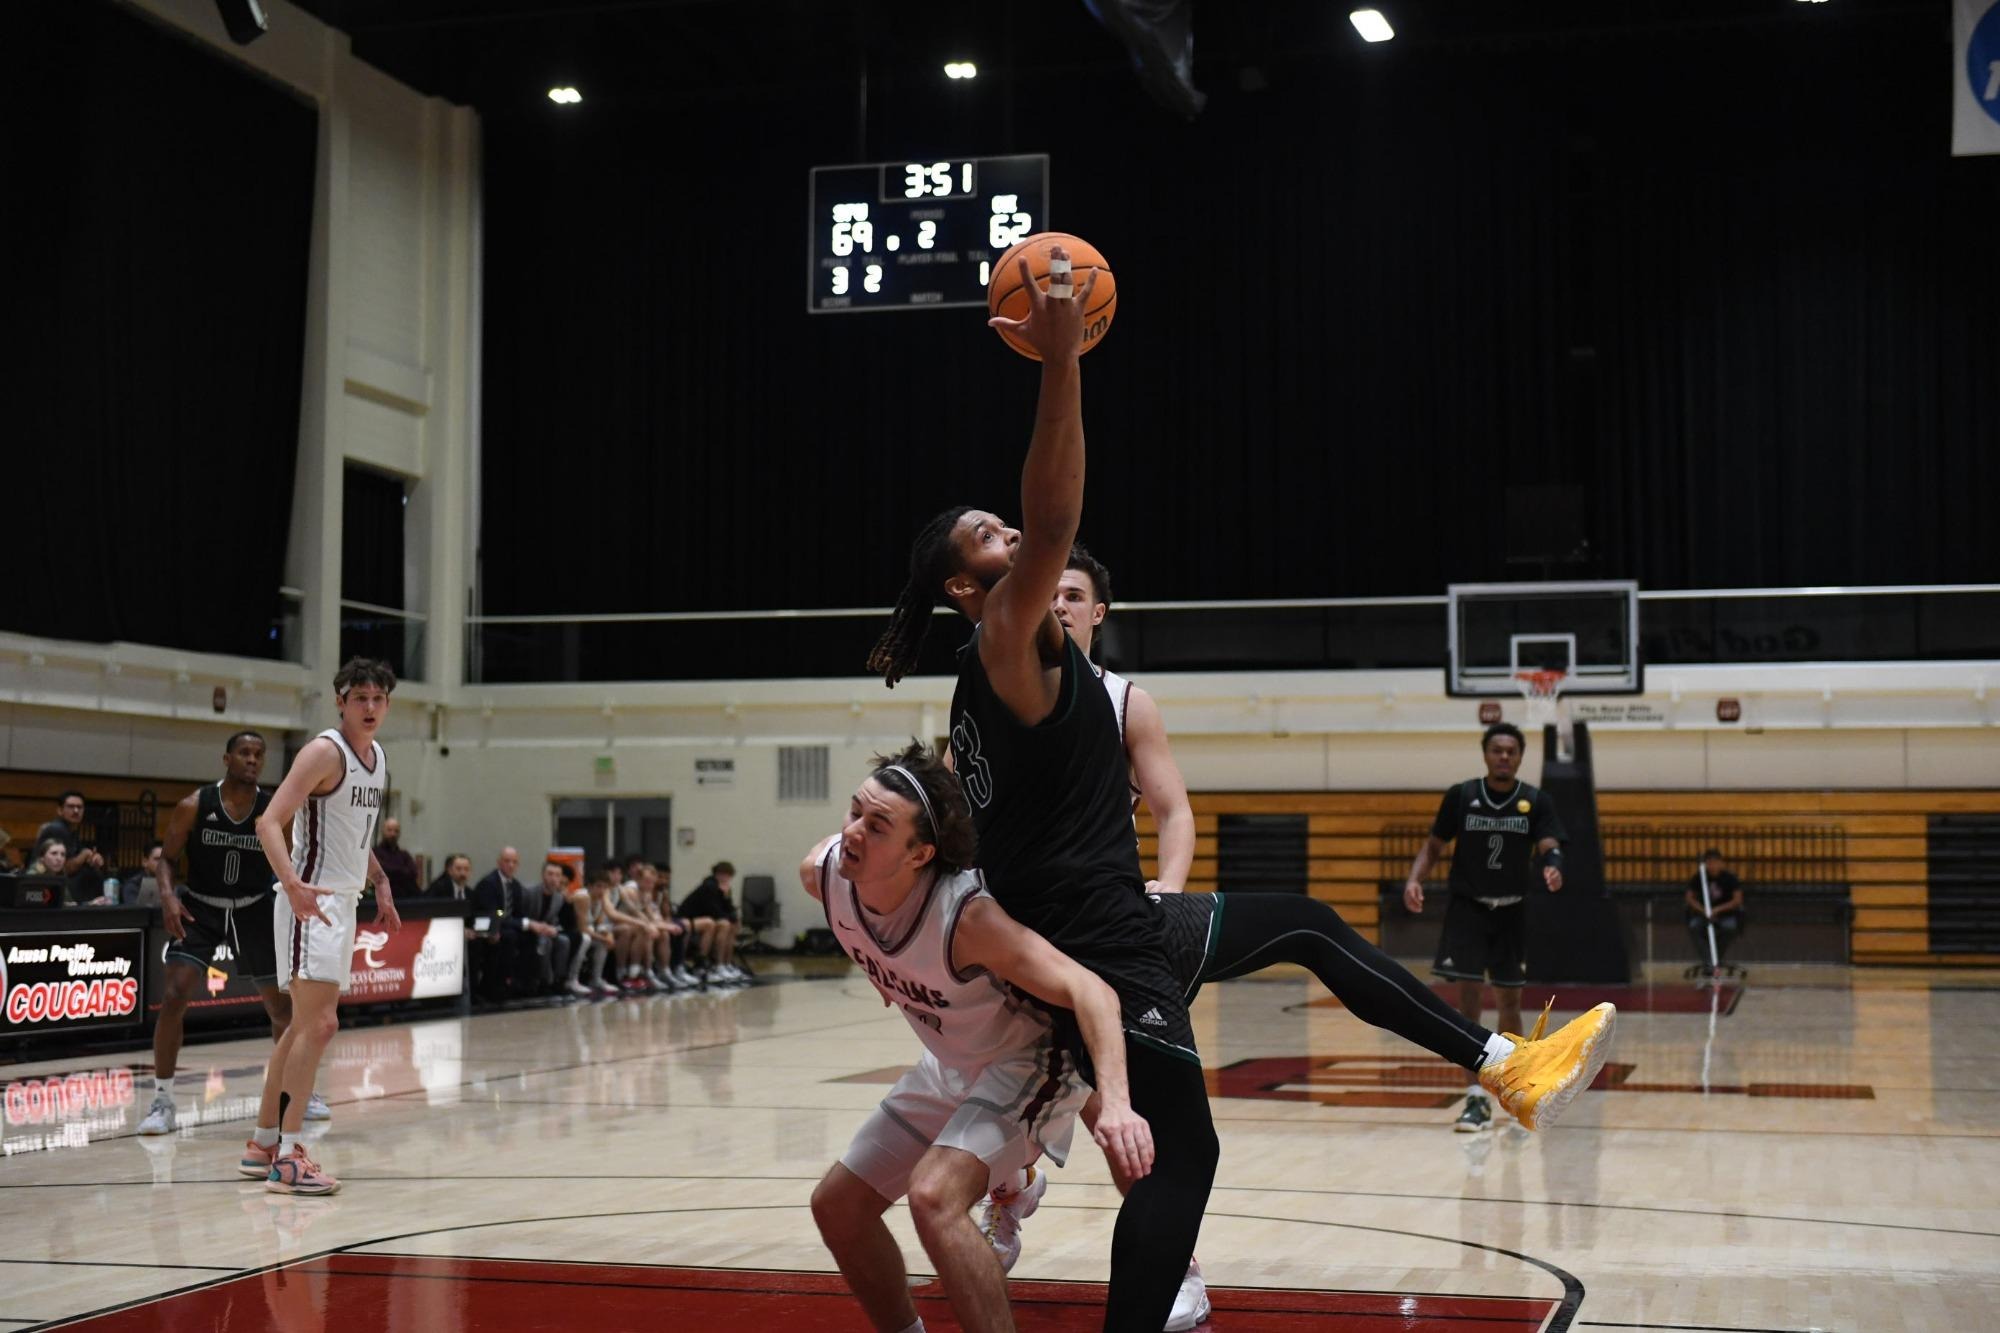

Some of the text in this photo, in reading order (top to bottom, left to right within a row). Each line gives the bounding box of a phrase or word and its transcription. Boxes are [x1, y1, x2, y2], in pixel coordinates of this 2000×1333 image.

[905, 162, 972, 198] 3:51
[832, 221, 873, 256] 69
[918, 221, 936, 248] 2
[990, 212, 1031, 248] 62
[832, 266, 848, 294] 3
[864, 265, 882, 292] 2
[224, 850, 240, 885] 0
[1487, 834, 1504, 869] 2
[7, 943, 95, 963] Azusa Pacific
[68, 957, 131, 976] University
[7, 976, 138, 1023] COUGARS
